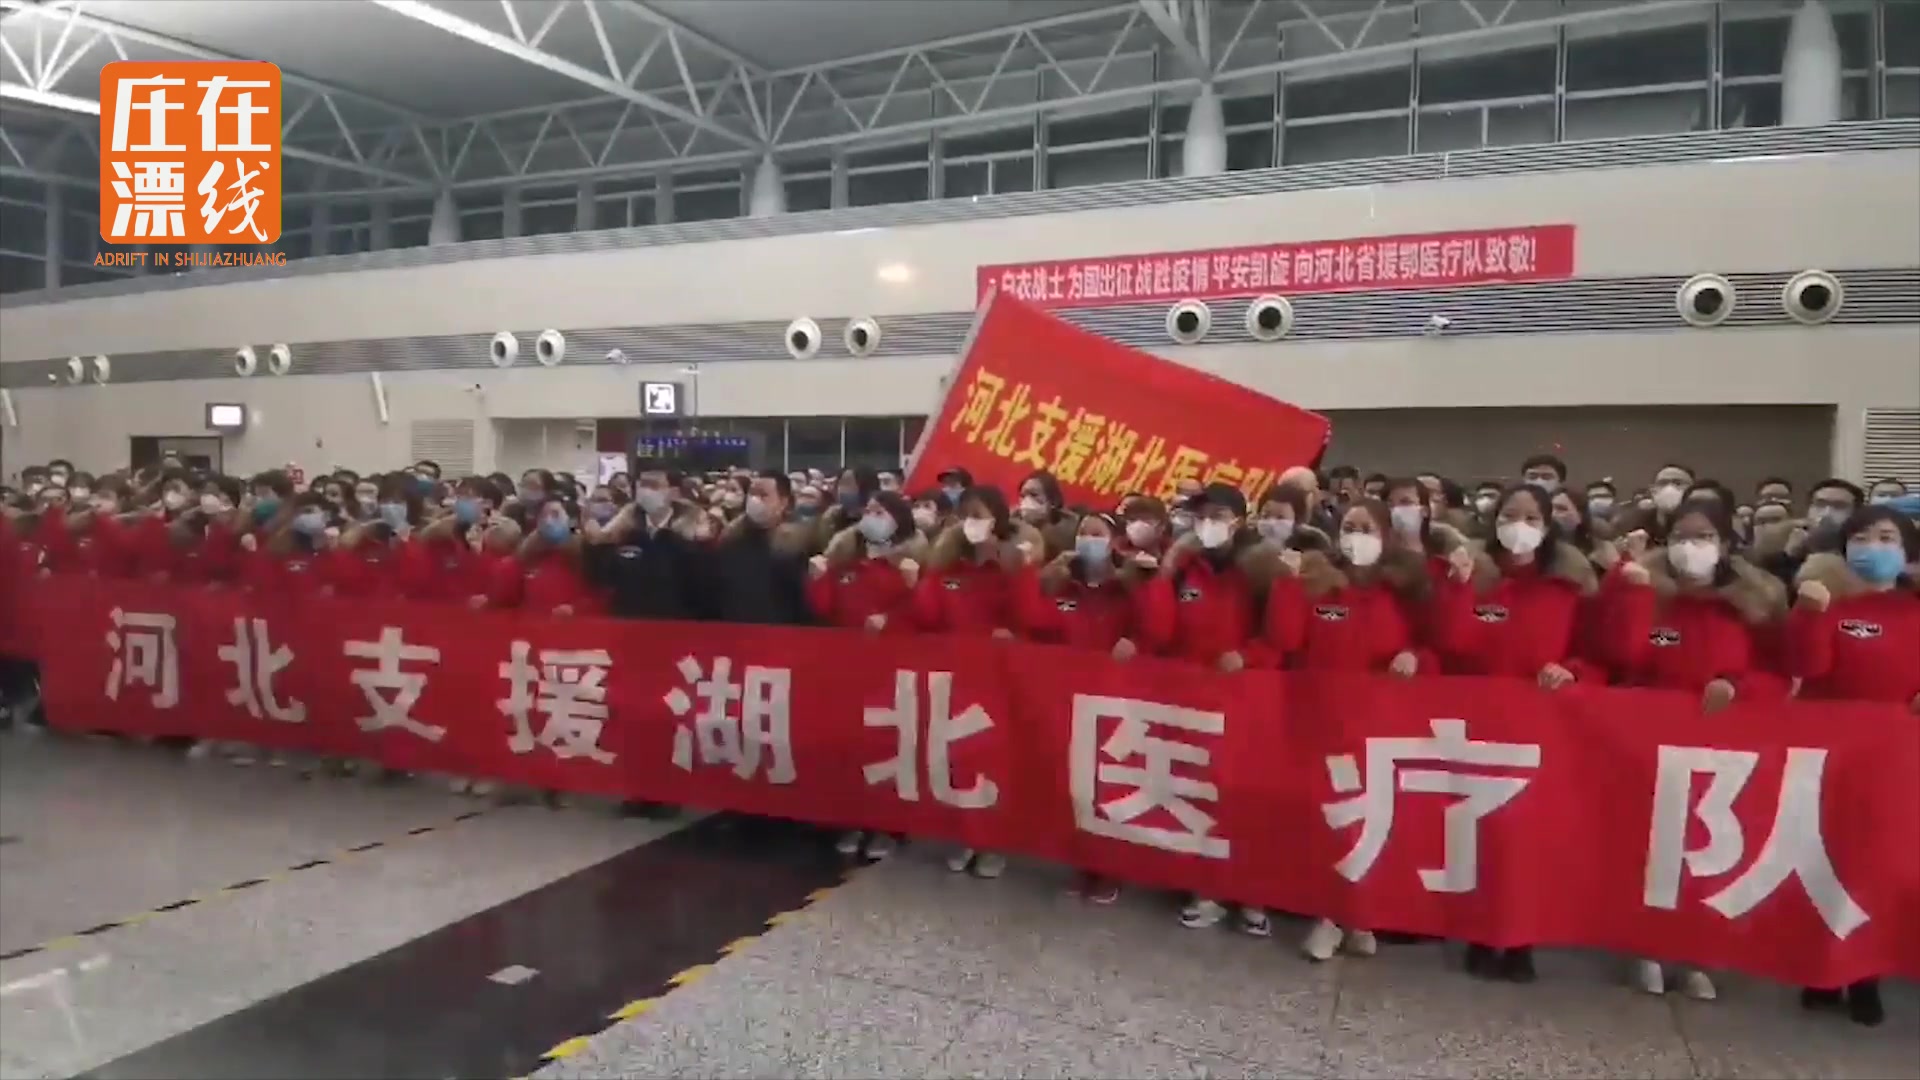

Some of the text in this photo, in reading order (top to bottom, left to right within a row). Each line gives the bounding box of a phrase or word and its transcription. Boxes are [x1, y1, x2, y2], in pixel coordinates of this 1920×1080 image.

[105, 606, 1869, 941] 河北支援湖北医疗队
